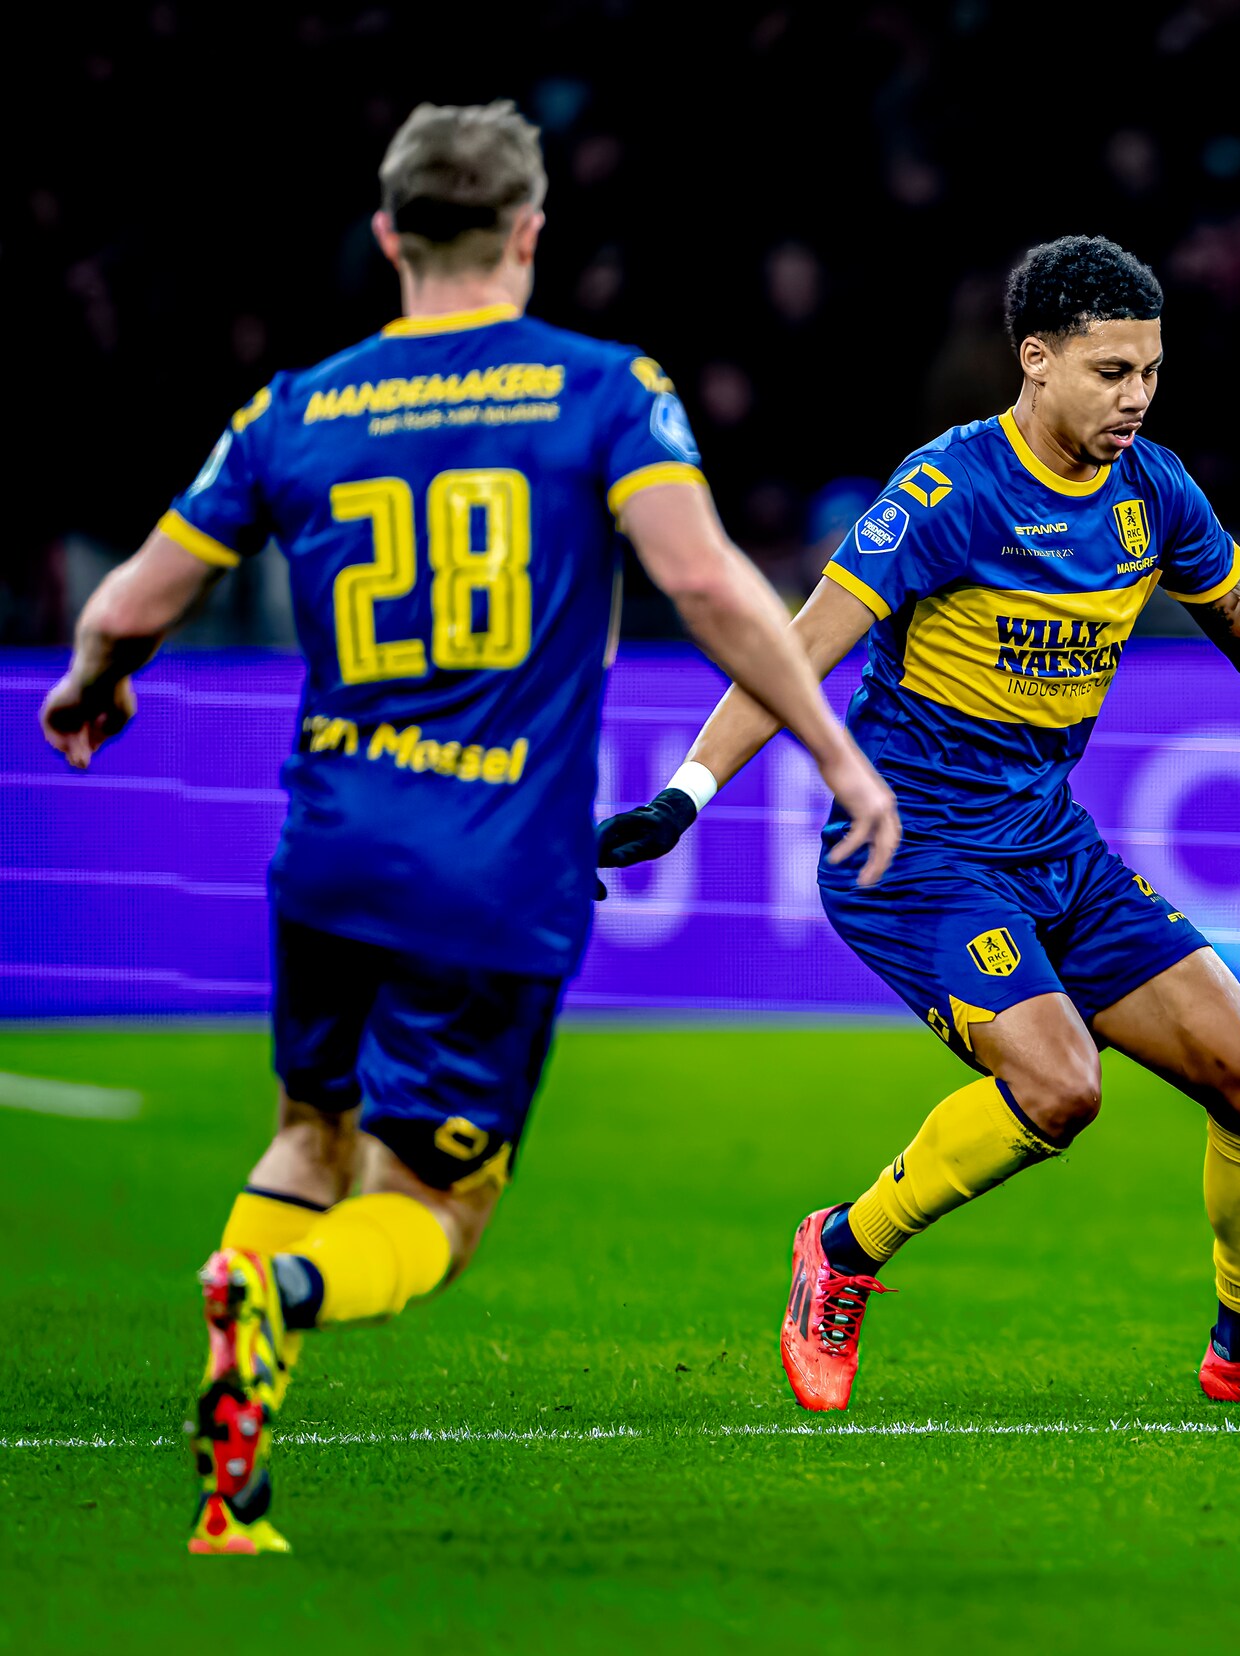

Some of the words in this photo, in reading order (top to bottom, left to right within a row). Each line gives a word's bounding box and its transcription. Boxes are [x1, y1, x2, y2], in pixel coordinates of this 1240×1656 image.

[863, 519, 894, 544] VRIENDEN
[1014, 522, 1068, 536] STANNO
[1127, 527, 1142, 539] RKC
[329, 467, 533, 685] 28
[995, 615, 1113, 649] WILLY
[987, 950, 1009, 964] RKC
